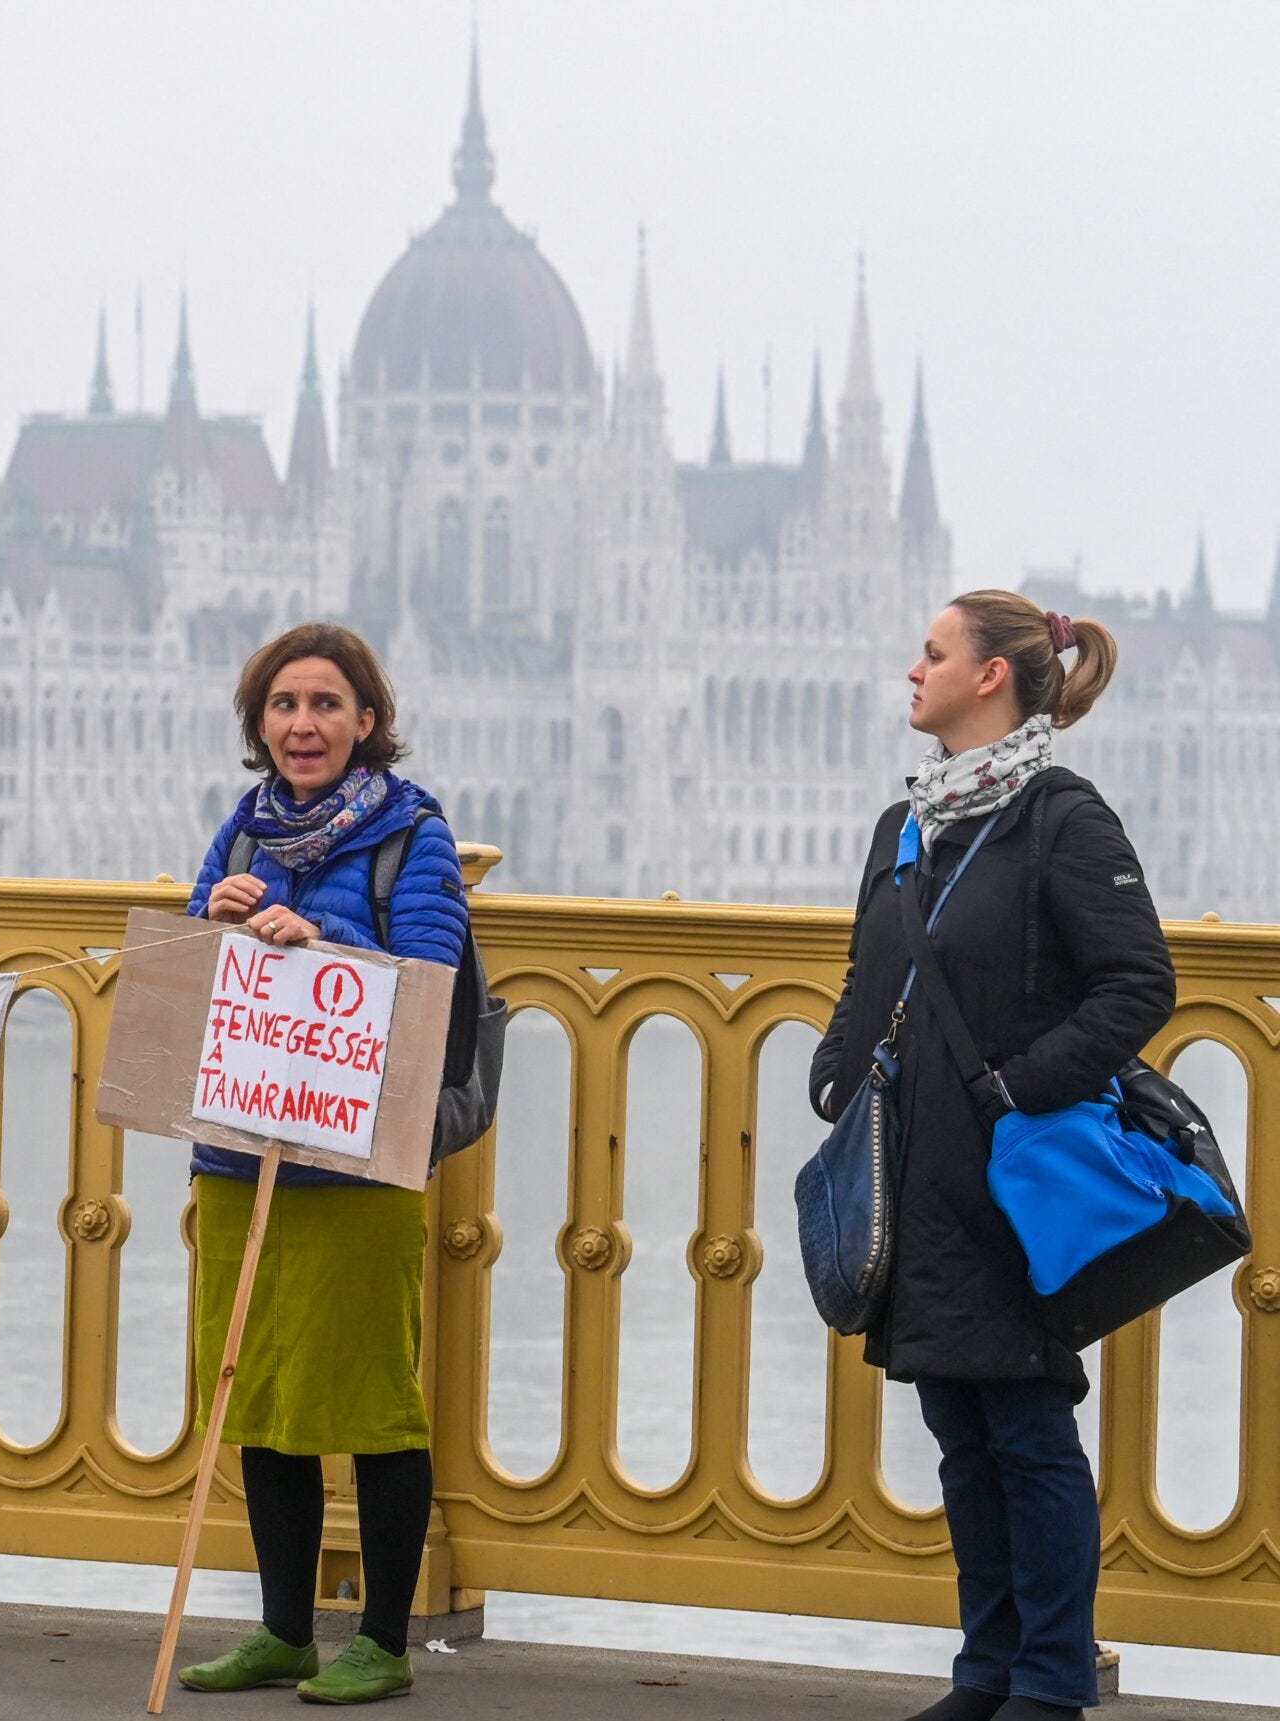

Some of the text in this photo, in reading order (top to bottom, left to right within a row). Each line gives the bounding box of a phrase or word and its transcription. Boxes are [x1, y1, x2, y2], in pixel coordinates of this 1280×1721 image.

[222, 946, 285, 1001] NE
[207, 1042, 223, 1064] A
[200, 1067, 371, 1133] TANÁRAINKAT
